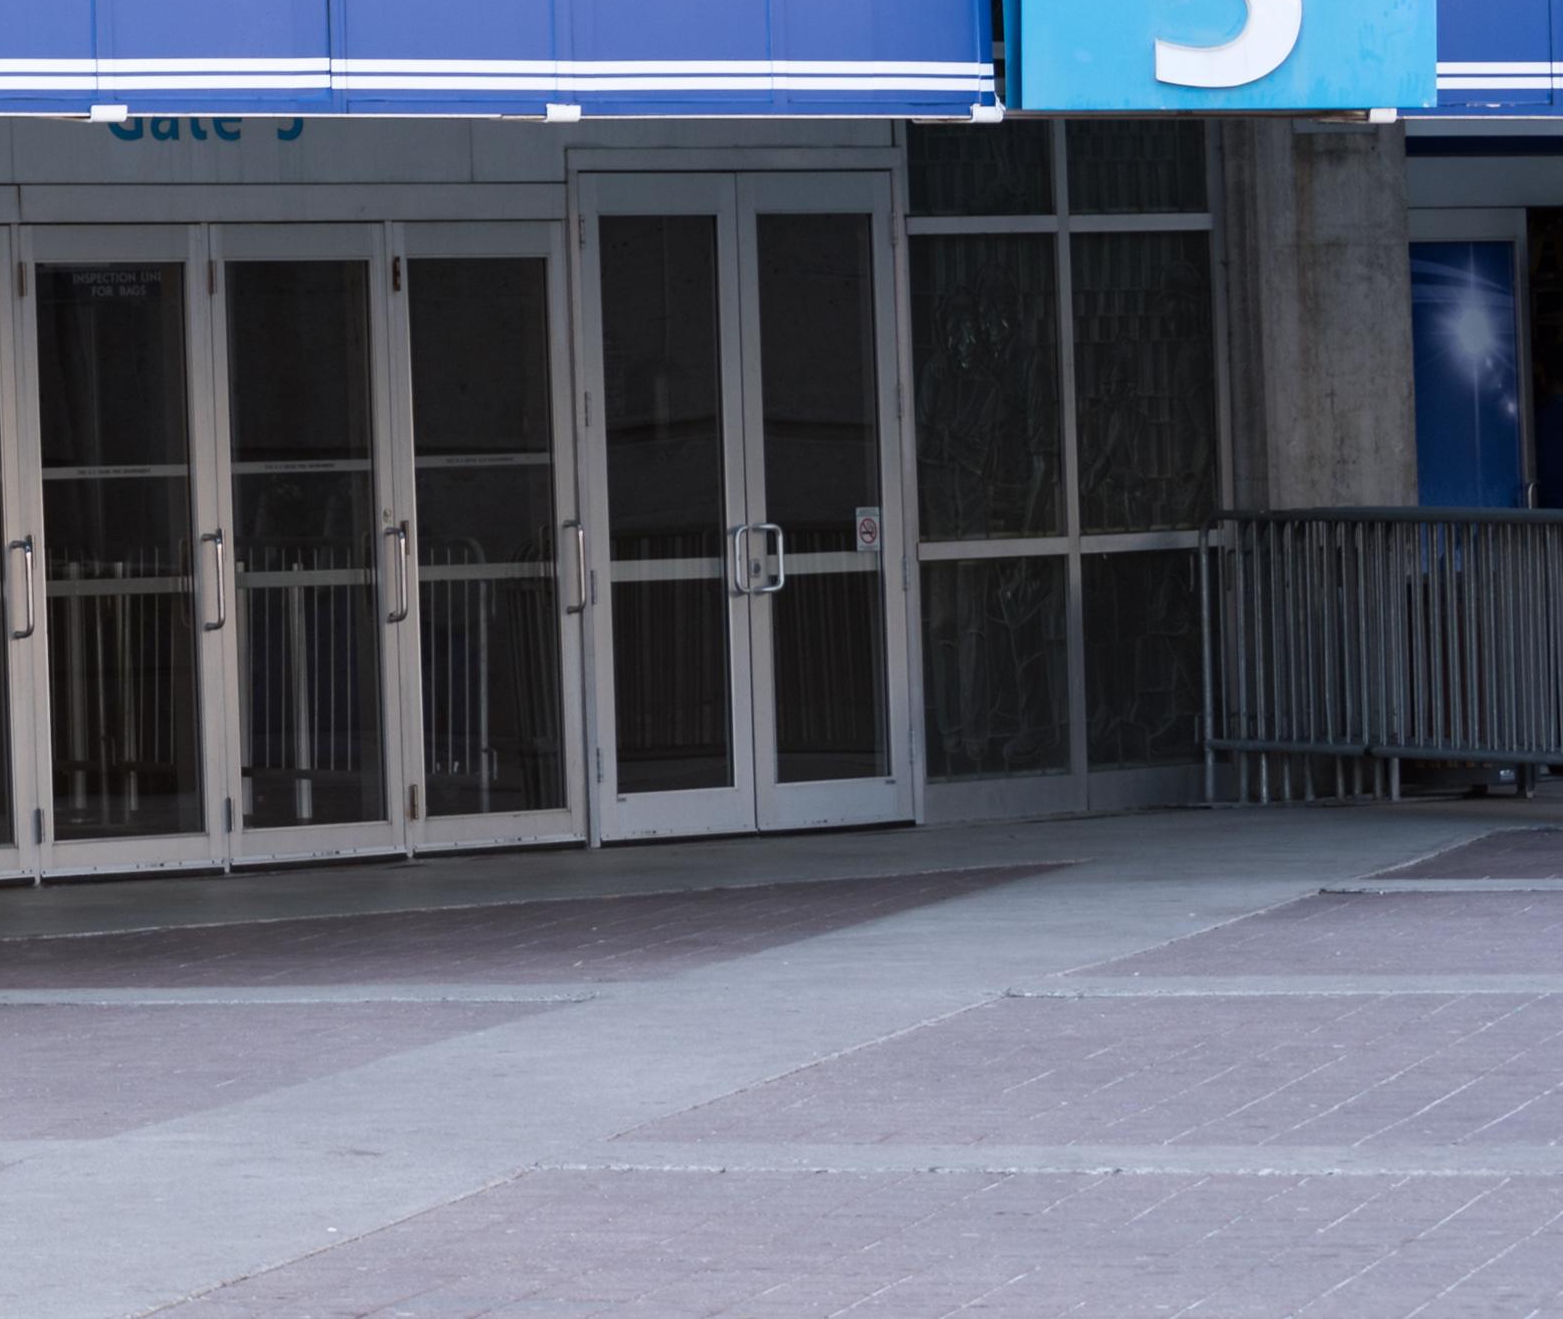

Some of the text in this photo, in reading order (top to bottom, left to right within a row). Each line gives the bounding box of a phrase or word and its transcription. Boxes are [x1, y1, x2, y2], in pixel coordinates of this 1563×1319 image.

[72, 271, 137, 284] INSPECTION
[91, 285, 147, 297] FOR BAGS
